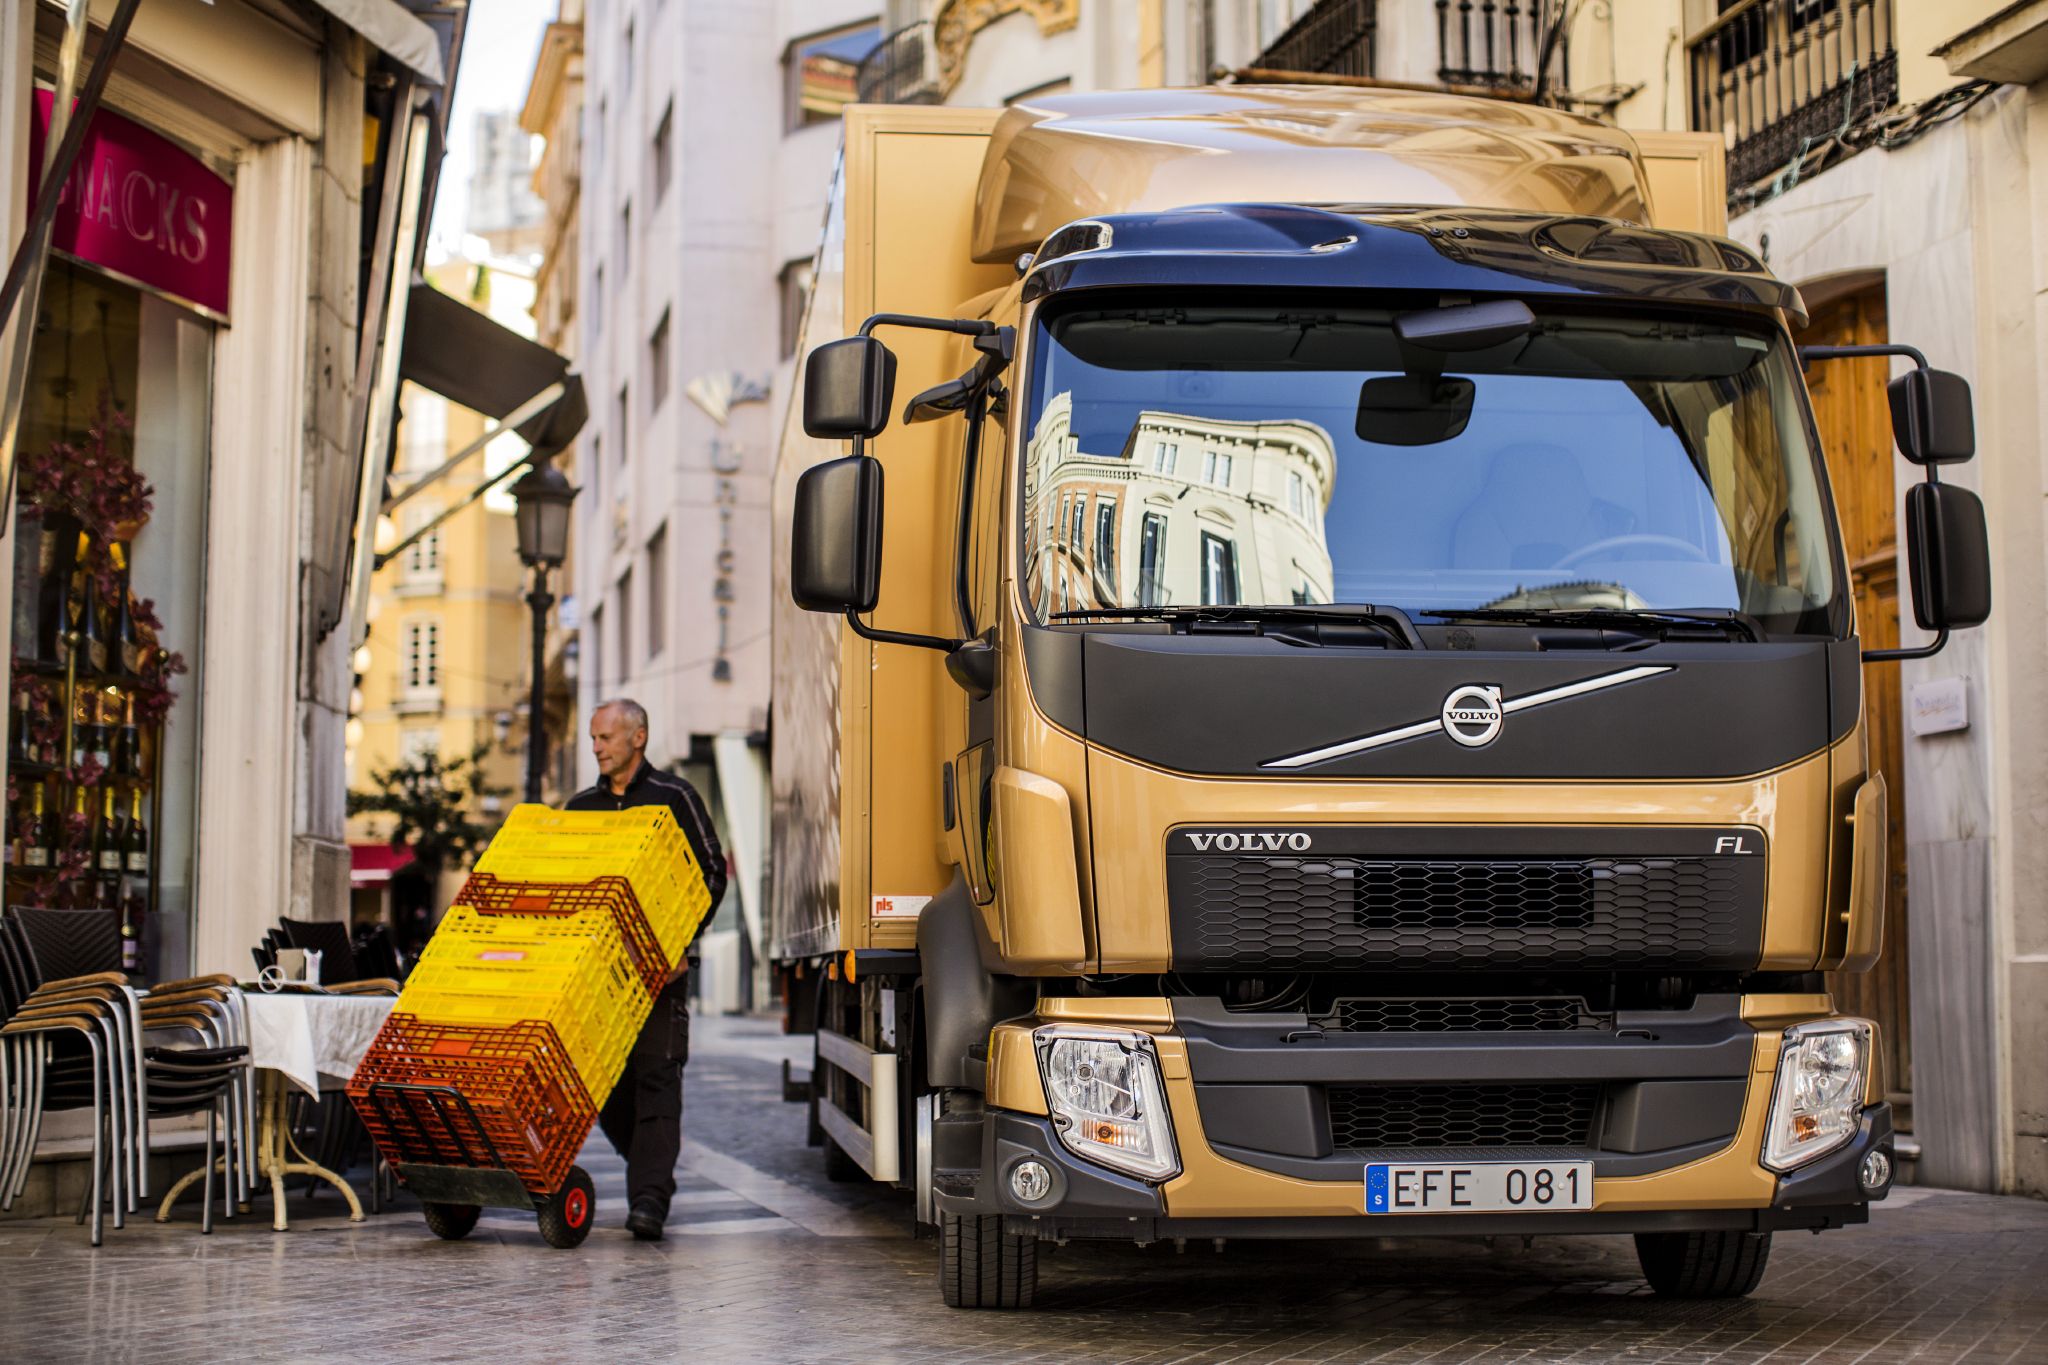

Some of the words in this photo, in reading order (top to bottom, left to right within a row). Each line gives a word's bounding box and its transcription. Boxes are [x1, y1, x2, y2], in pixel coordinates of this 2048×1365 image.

[56, 150, 209, 264] NACKS
[1446, 711, 1499, 721] VOLVO
[1185, 832, 1312, 851] VOLVO
[1714, 836, 1753, 854] FL
[876, 897, 893, 914] pls
[1394, 1169, 1472, 1207] EFE
[1506, 1168, 1578, 1205] 081
[1374, 1194, 1383, 1205] S
